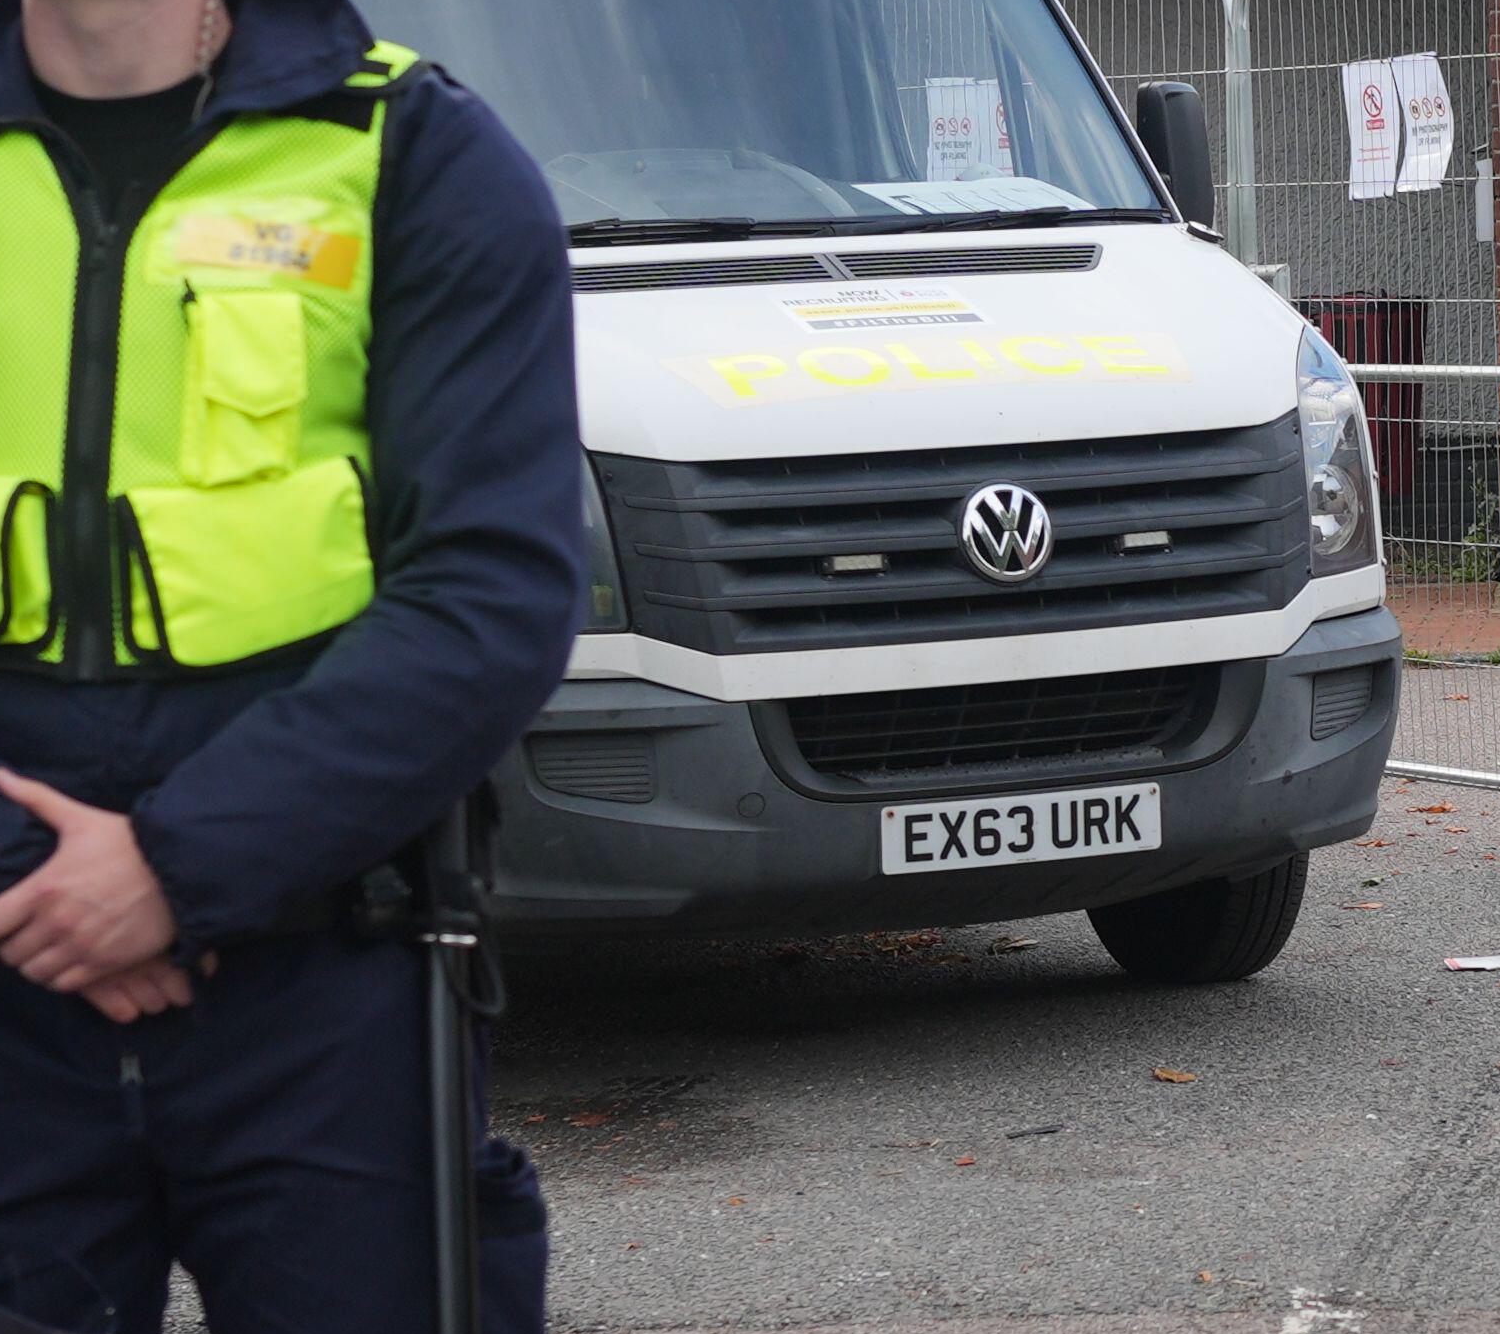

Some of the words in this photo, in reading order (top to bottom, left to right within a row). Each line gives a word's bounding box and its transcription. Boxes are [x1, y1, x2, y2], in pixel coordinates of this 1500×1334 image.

[782, 295, 889, 308] RECRUITING
[838, 288, 880, 297] NOW
[706, 335, 1172, 397] POLICE
[904, 805, 1035, 863] EX63
[1051, 794, 1142, 849] URK
